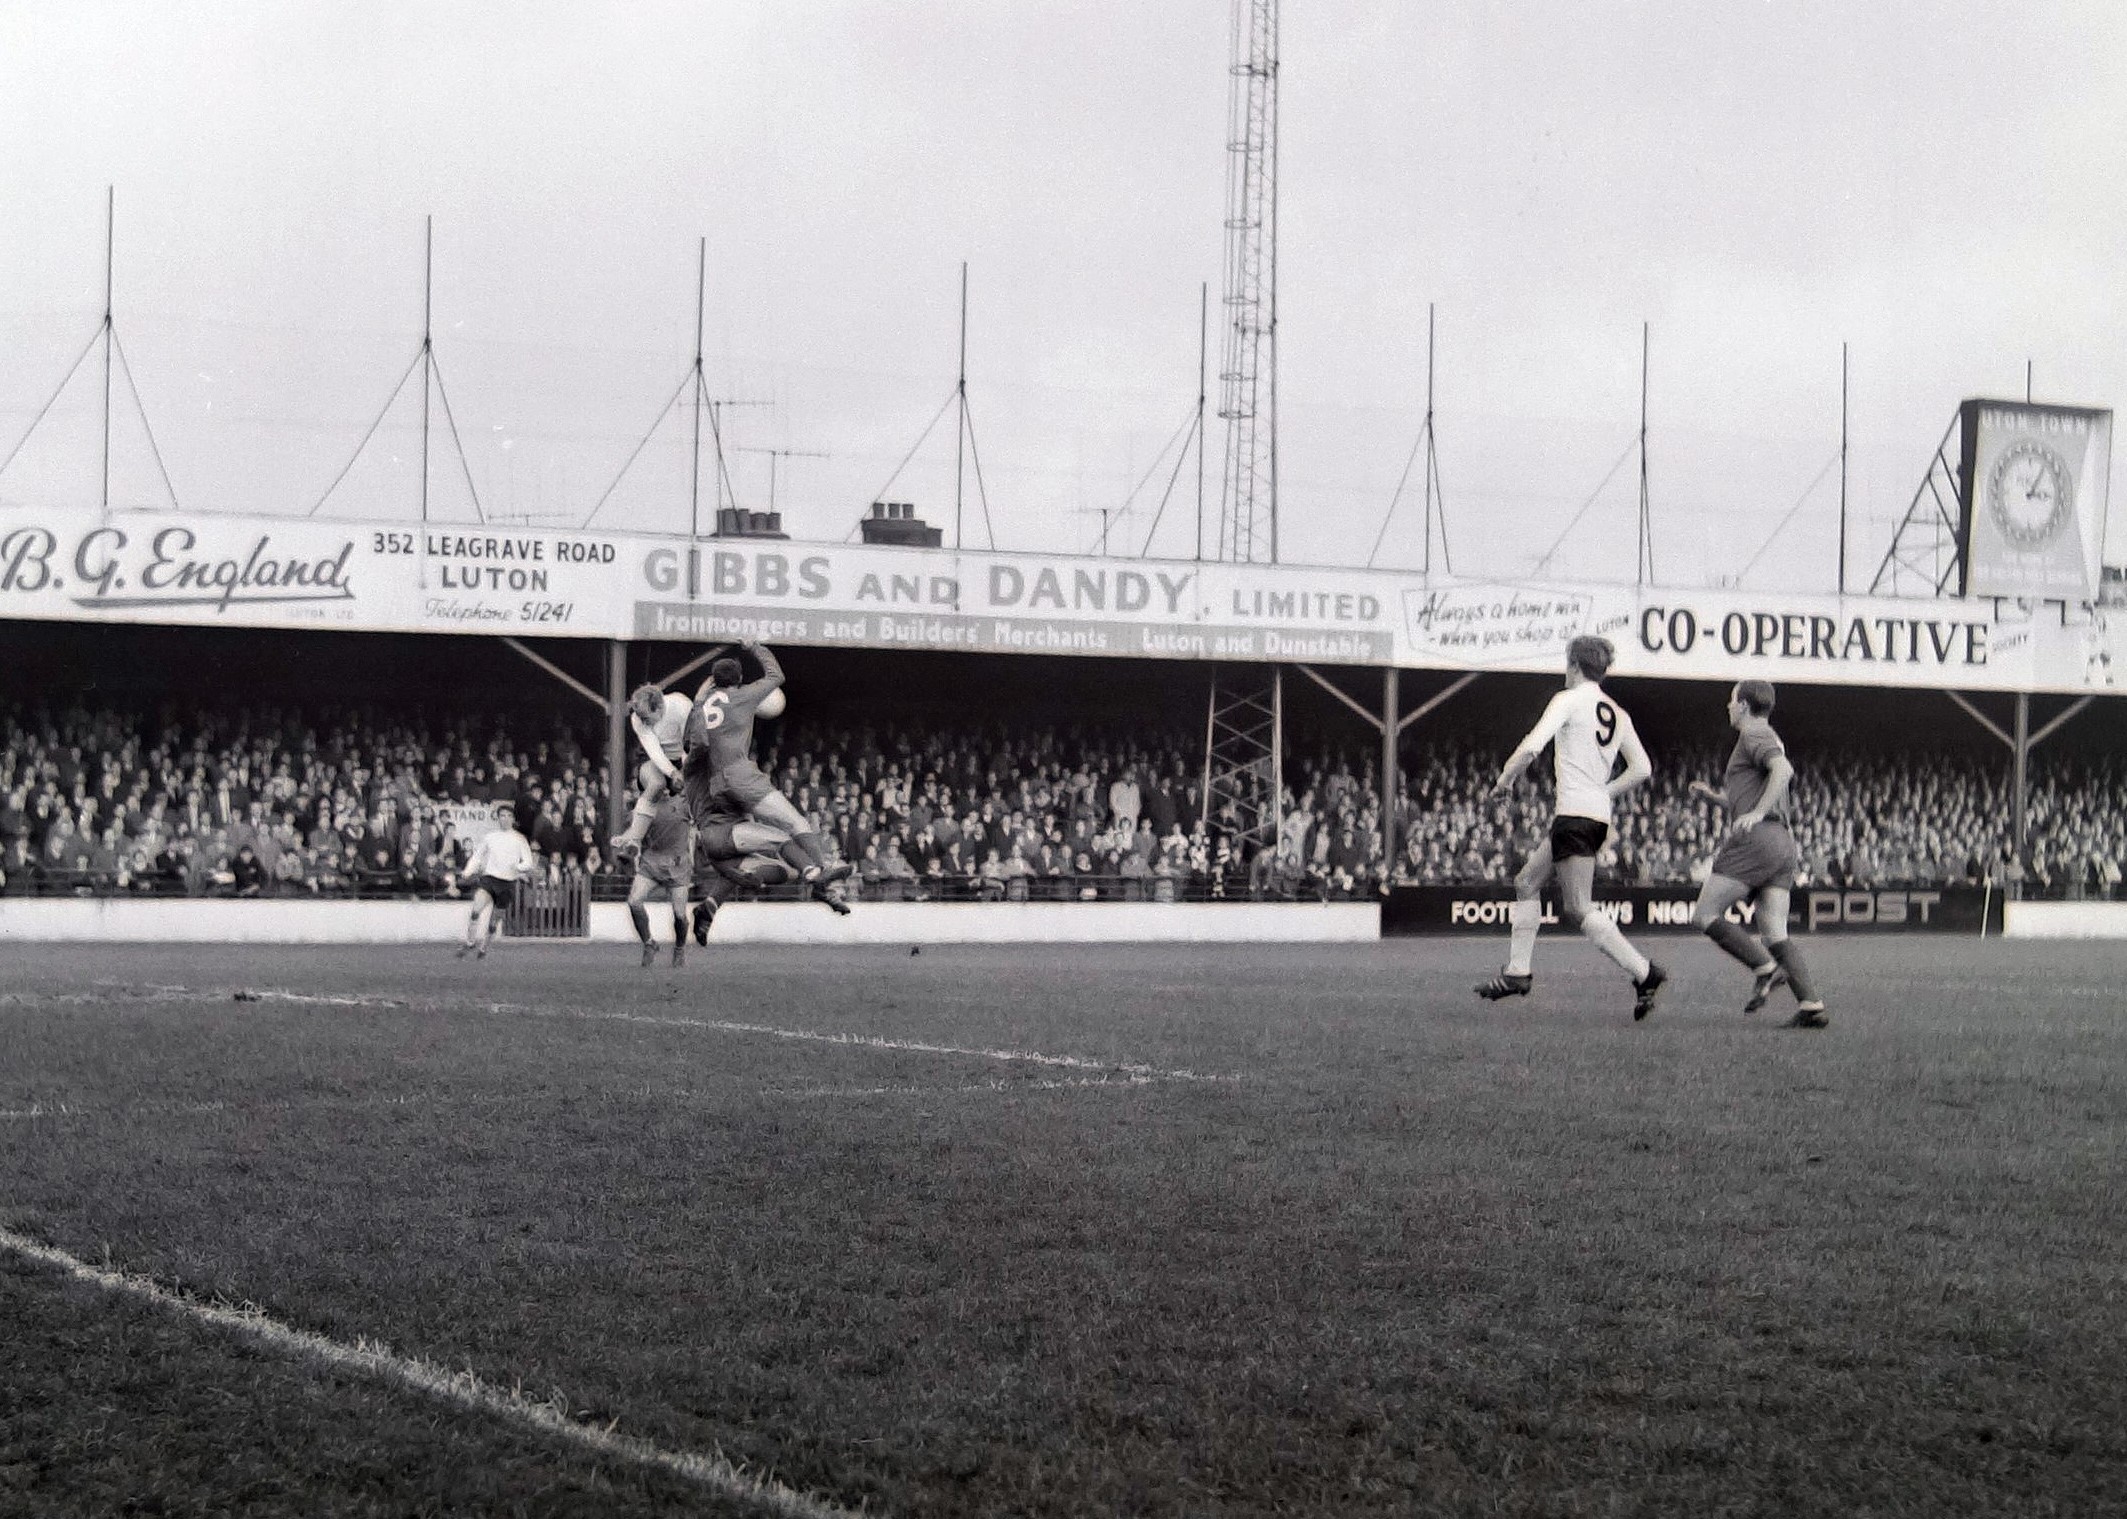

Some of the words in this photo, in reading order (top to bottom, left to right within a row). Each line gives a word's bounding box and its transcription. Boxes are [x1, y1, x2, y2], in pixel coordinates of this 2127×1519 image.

[142, 527, 355, 612] England
[374, 533, 415, 555] 352
[427, 535, 545, 561] LEAGRAVE
[556, 541, 616, 563] ROAD
[442, 565, 549, 591] LUTON
[643, 548, 831, 599] GIBBS
[855, 573, 958, 606] AND
[1232, 588, 1380, 622] LIMITED
[425, 598, 513, 622] Telephone
[657, 605, 807, 641] Ironmongers
[823, 615, 866, 639] and
[995, 620, 1107, 648] Merchants
[1143, 627, 1204, 652] Luton
[1215, 631, 1253, 653] and
[1265, 631, 1371, 658] Dunstable
[1640, 605, 1989, 666] CO-OPERATIVE
[703, 691, 730, 730] 6
[1596, 701, 1616, 747] 9
